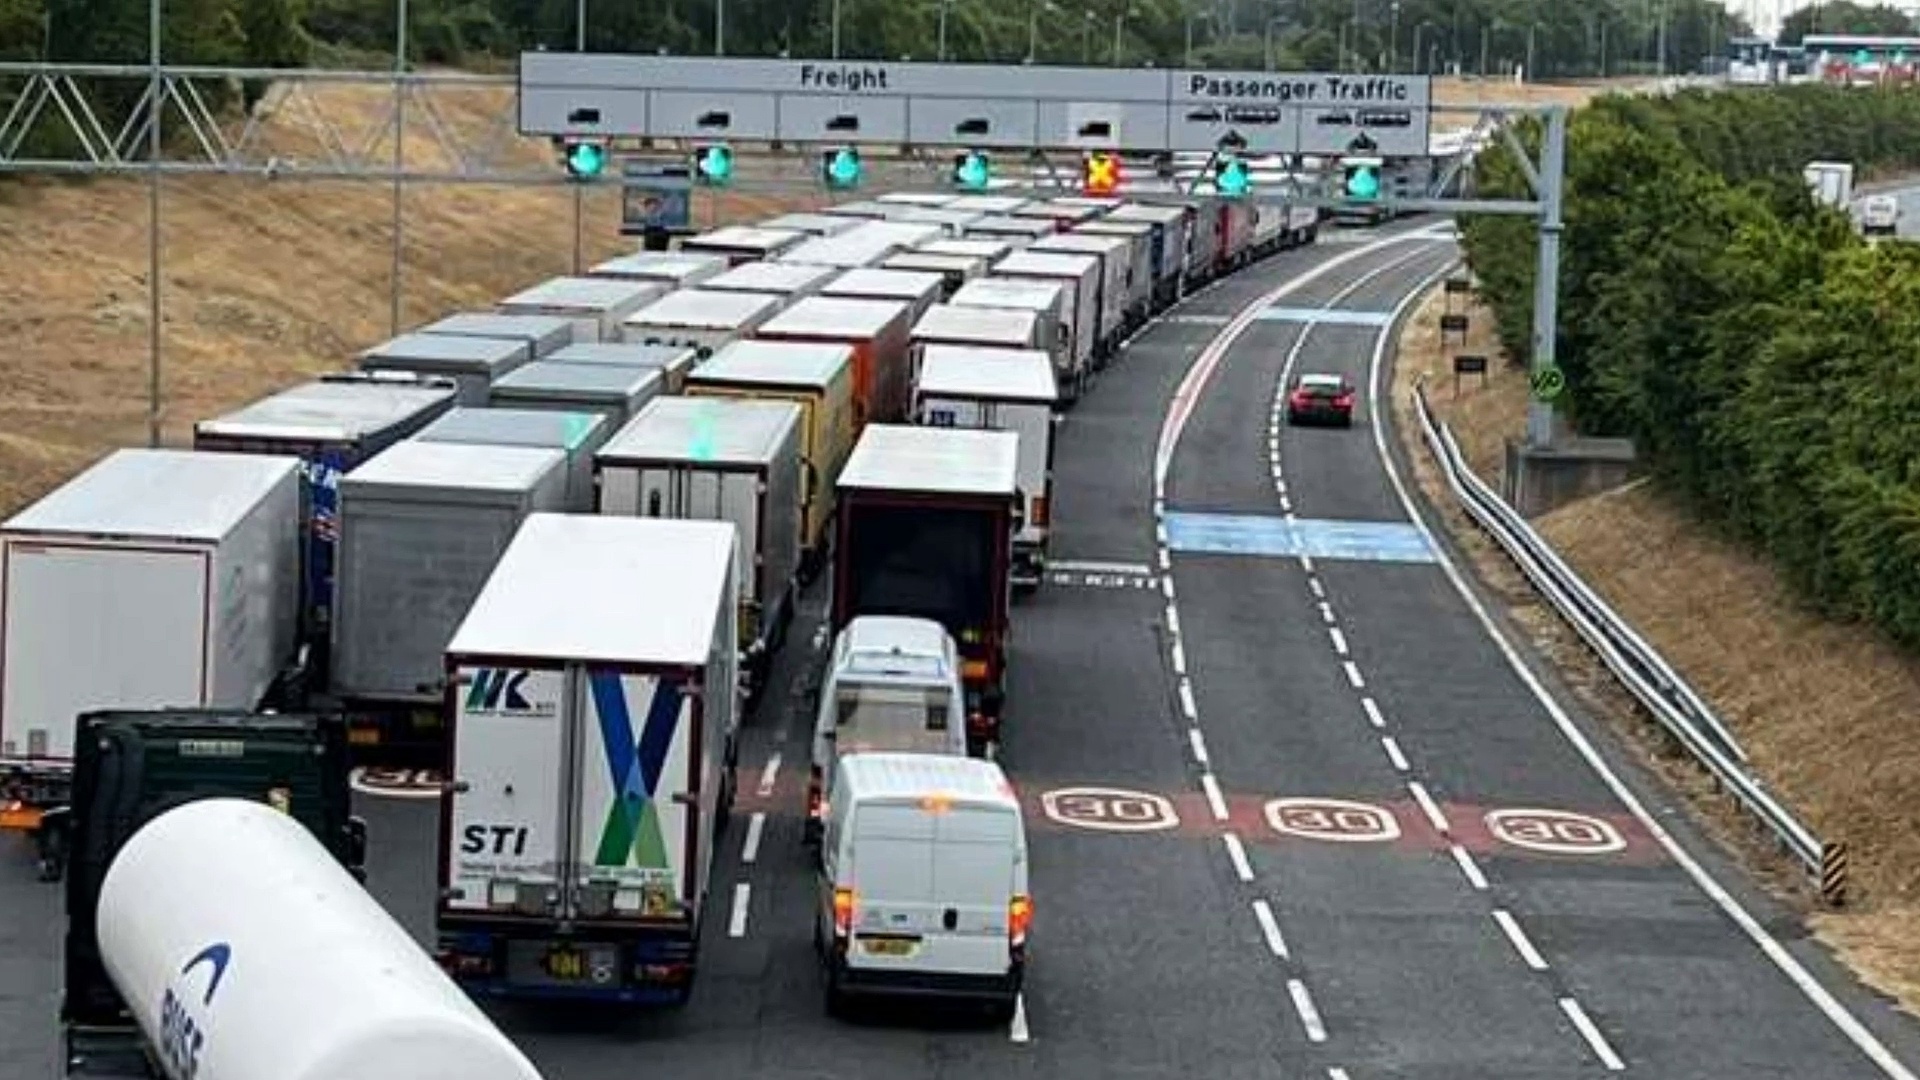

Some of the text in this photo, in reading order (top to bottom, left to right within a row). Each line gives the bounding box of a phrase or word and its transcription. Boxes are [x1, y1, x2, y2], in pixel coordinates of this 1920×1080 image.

[801, 64, 887, 91] Freight
[1190, 74, 1408, 100] Passenger Traffic
[1061, 796, 1156, 820] 30
[1282, 807, 1380, 832] 30
[460, 824, 528, 857] STI
[1504, 818, 1603, 843] 30
